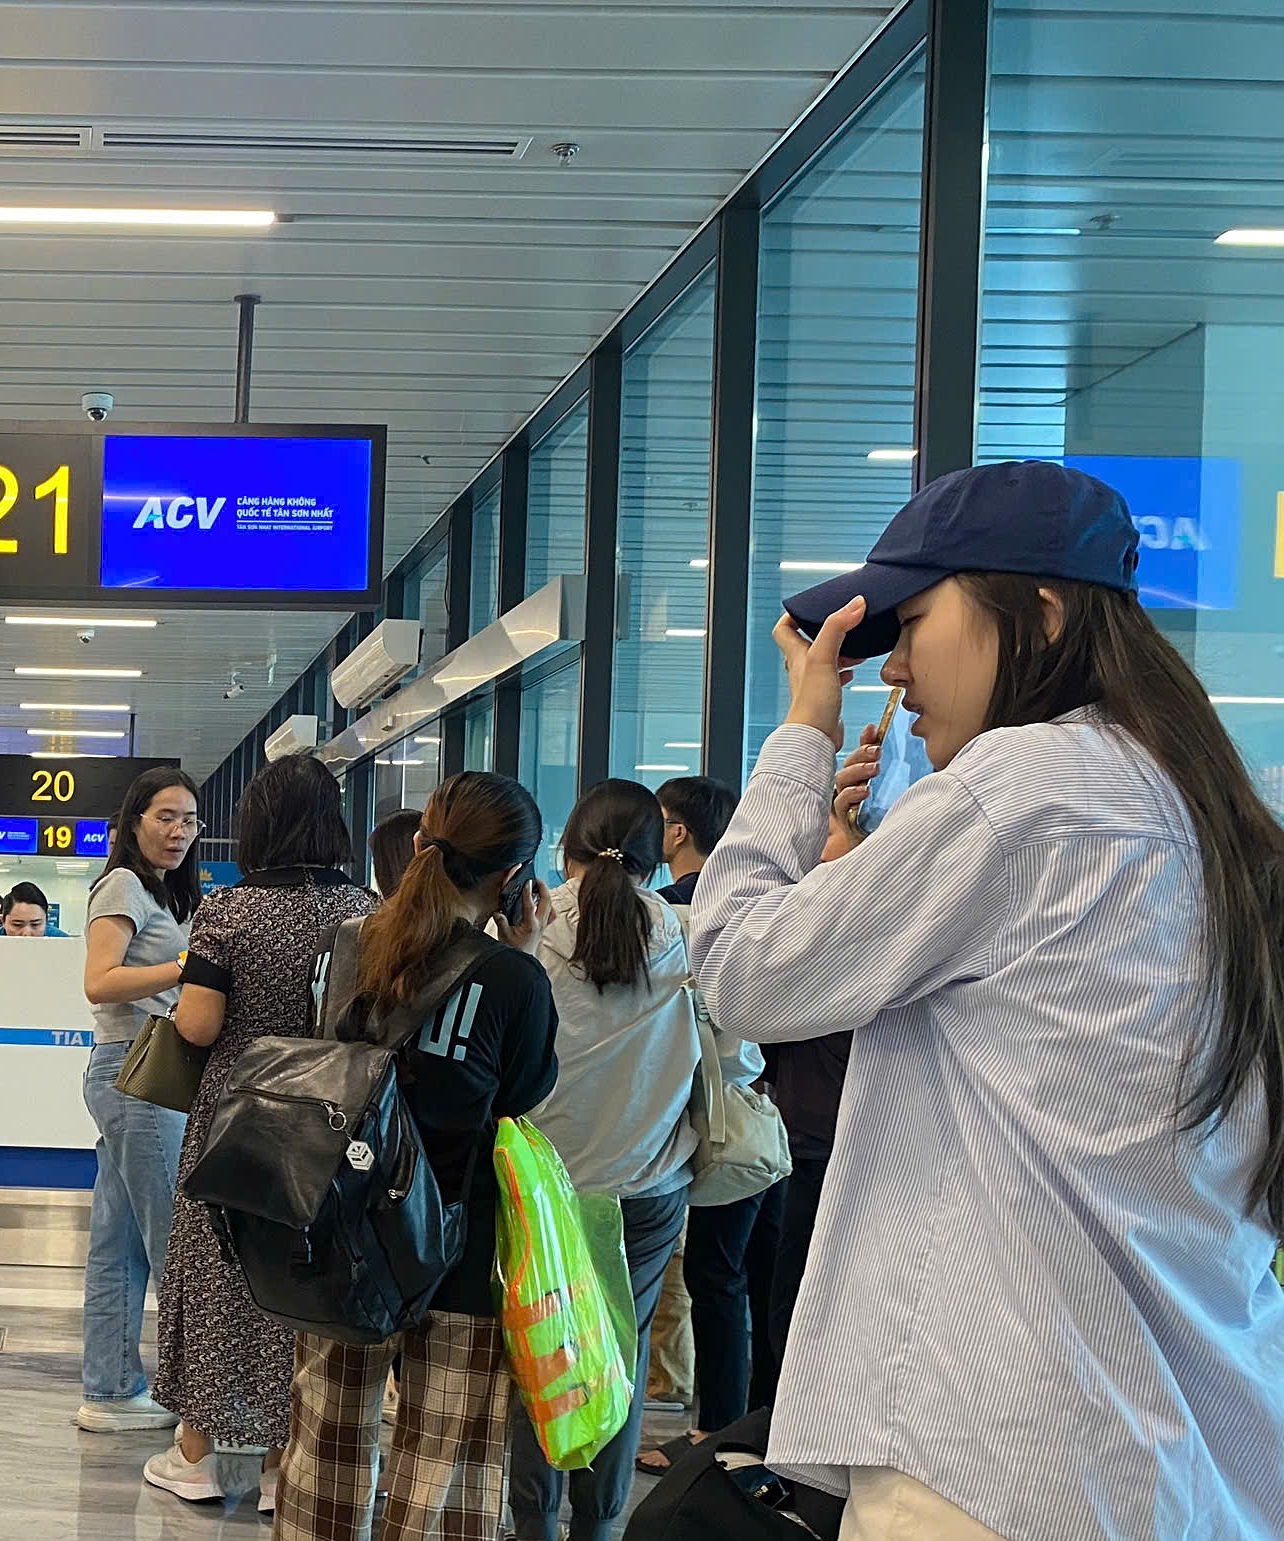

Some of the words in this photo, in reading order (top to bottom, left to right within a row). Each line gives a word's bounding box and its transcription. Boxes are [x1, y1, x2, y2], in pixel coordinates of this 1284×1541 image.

[261, 496, 286, 506] HÀNG
[287, 496, 316, 506] KHÔNG
[133, 496, 226, 530] ACV
[237, 507, 260, 518] QUỐC
[31, 770, 75, 802] 20
[43, 825, 72, 849] 19
[83, 833, 105, 843] ACV
